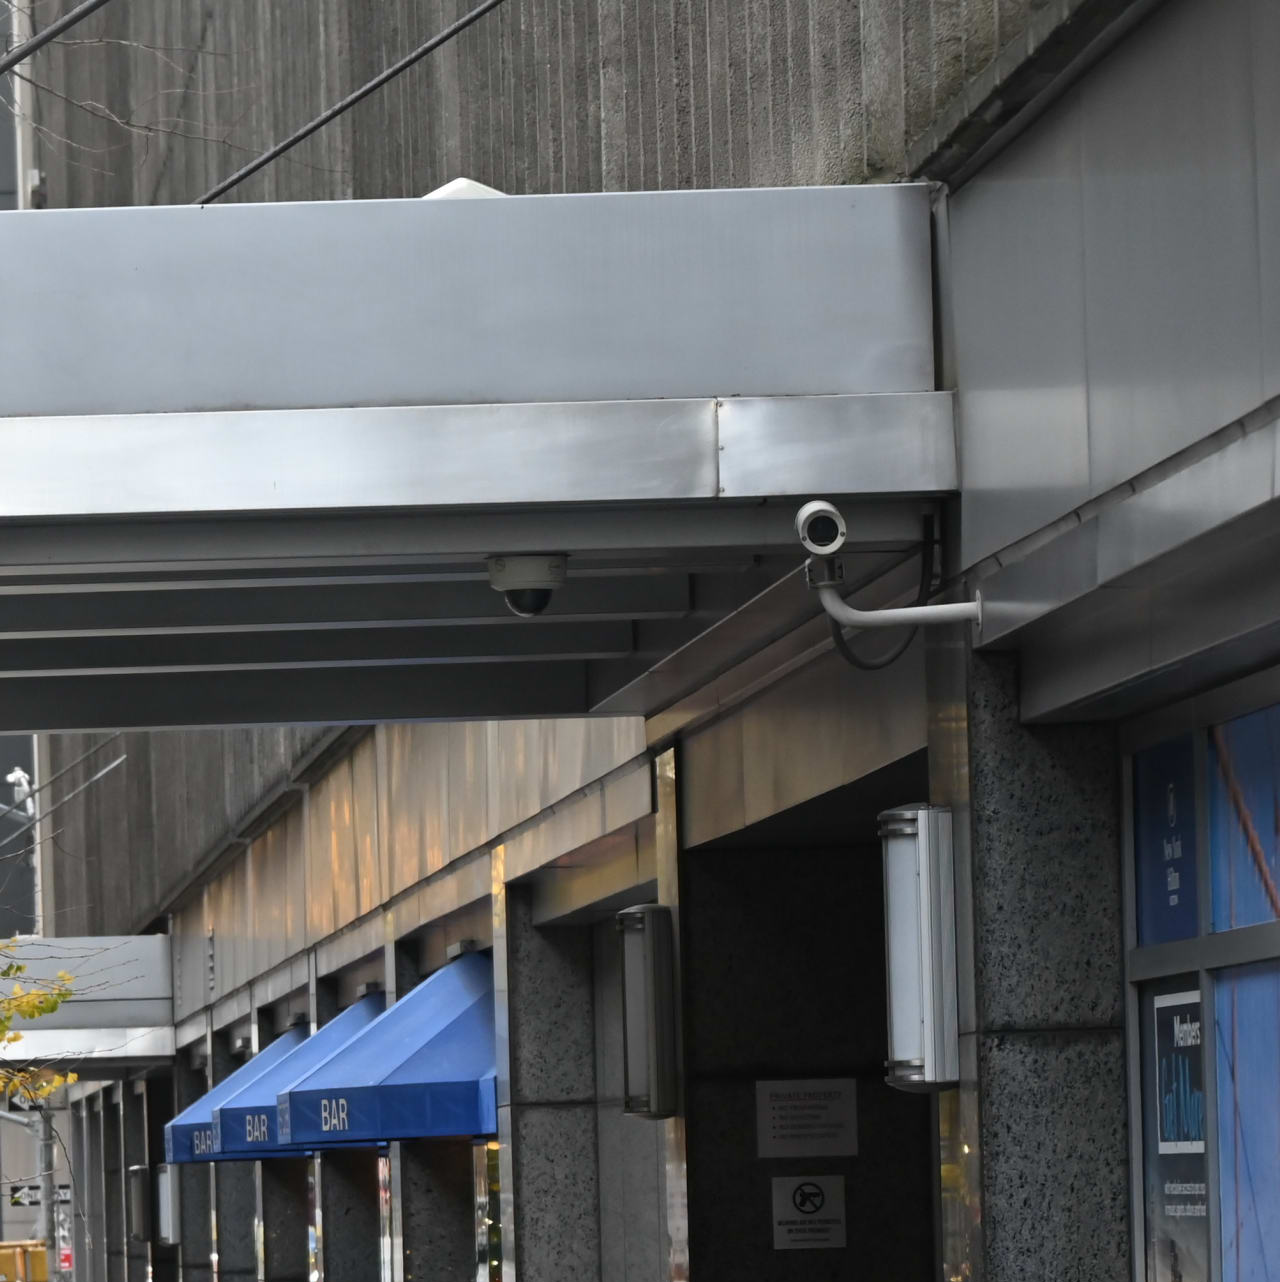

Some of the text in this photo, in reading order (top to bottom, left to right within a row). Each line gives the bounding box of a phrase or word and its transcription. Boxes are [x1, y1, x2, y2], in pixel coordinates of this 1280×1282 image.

[1173, 1014, 1201, 1047] Members
[246, 1114, 268, 1142] BAR
[321, 1098, 348, 1132] BAR
[194, 1130, 214, 1155] BAR
